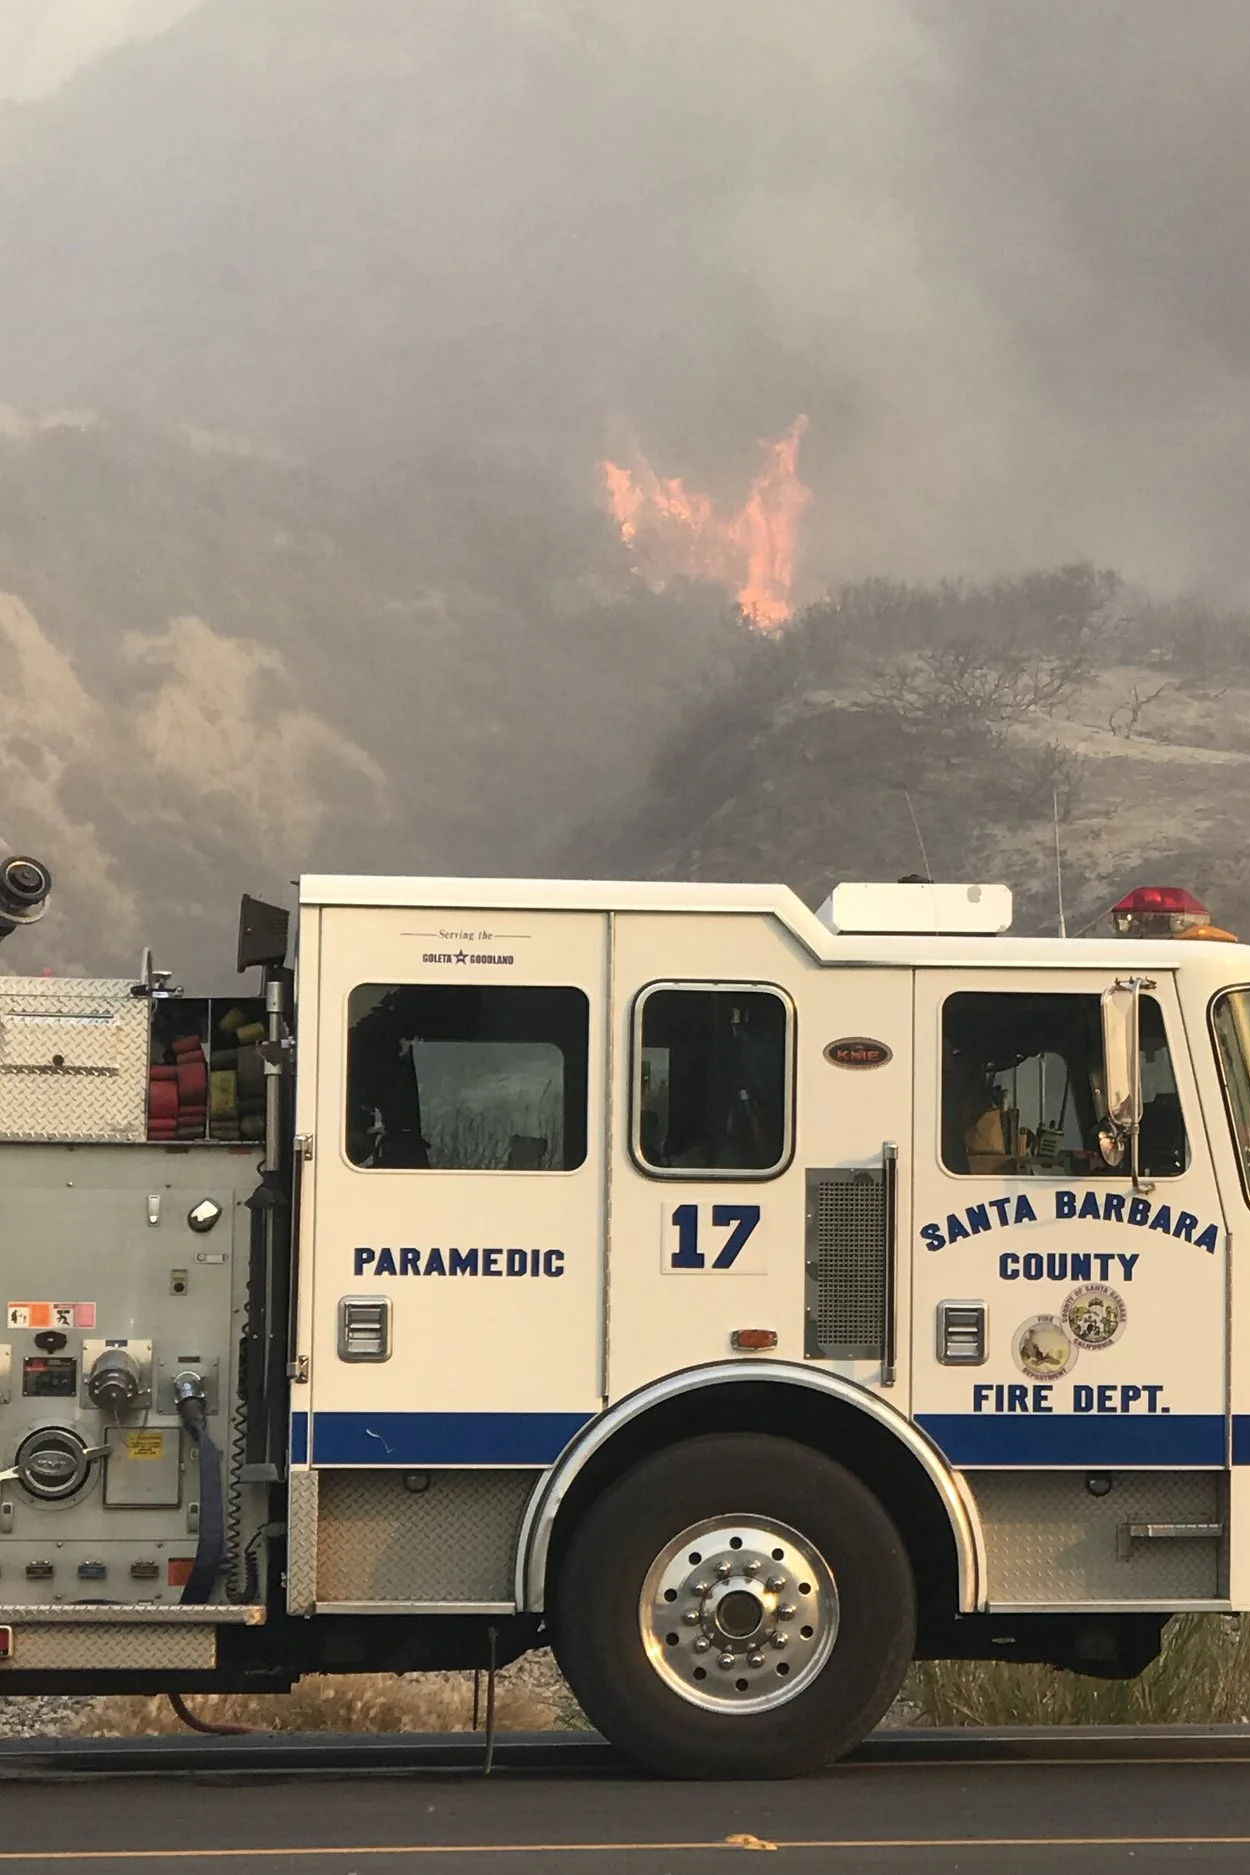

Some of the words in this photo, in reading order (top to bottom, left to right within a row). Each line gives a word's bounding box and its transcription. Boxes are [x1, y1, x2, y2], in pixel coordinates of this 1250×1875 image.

[438, 929, 475, 941] Serving
[478, 930, 493, 940] the
[422, 953, 453, 963] GOLETA
[469, 954, 514, 965] GOODLAND
[836, 1049, 880, 1061] KME
[671, 1204, 760, 1269] 17
[920, 1194, 1038, 1252] SANTA
[1055, 1190, 1219, 1255] BARBARA
[354, 1248, 565, 1277] PARAMEDIC
[999, 1252, 1140, 1282] COUNTY
[1037, 1314, 1054, 1323] FIRE
[1061, 1296, 1074, 1323] COUNTY
[1074, 1287, 1082, 1297] OF
[1085, 1285, 1108, 1294] SANTA
[1022, 1367, 1067, 1381] DEPARTMENT
[973, 1384, 1054, 1413] FIRE
[1073, 1385, 1170, 1413] DEPT.
